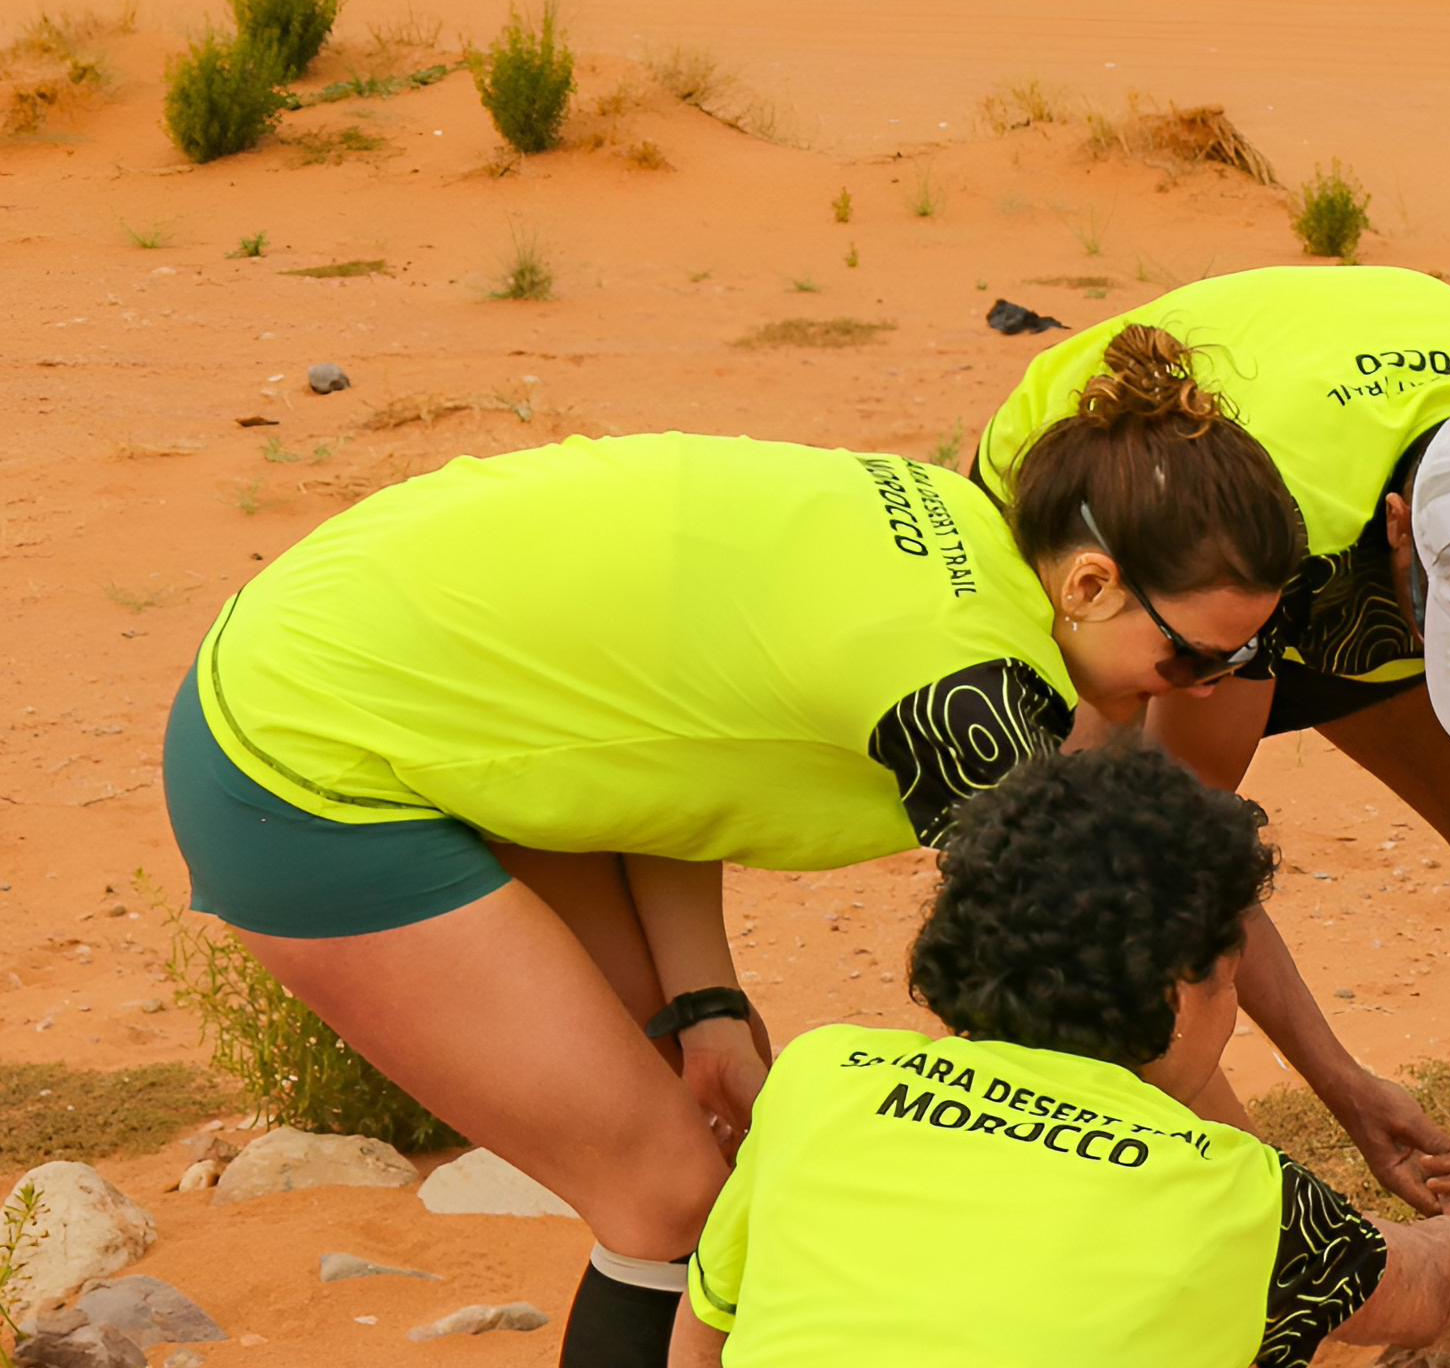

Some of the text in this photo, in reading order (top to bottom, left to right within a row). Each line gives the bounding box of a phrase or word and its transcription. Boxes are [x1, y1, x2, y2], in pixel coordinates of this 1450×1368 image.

[940, 540, 977, 598] TRAIL
[840, 1050, 976, 1093] SAARA
[1130, 1123, 1213, 1161] TAIL
[875, 1082, 1149, 1168] MOROCCO
